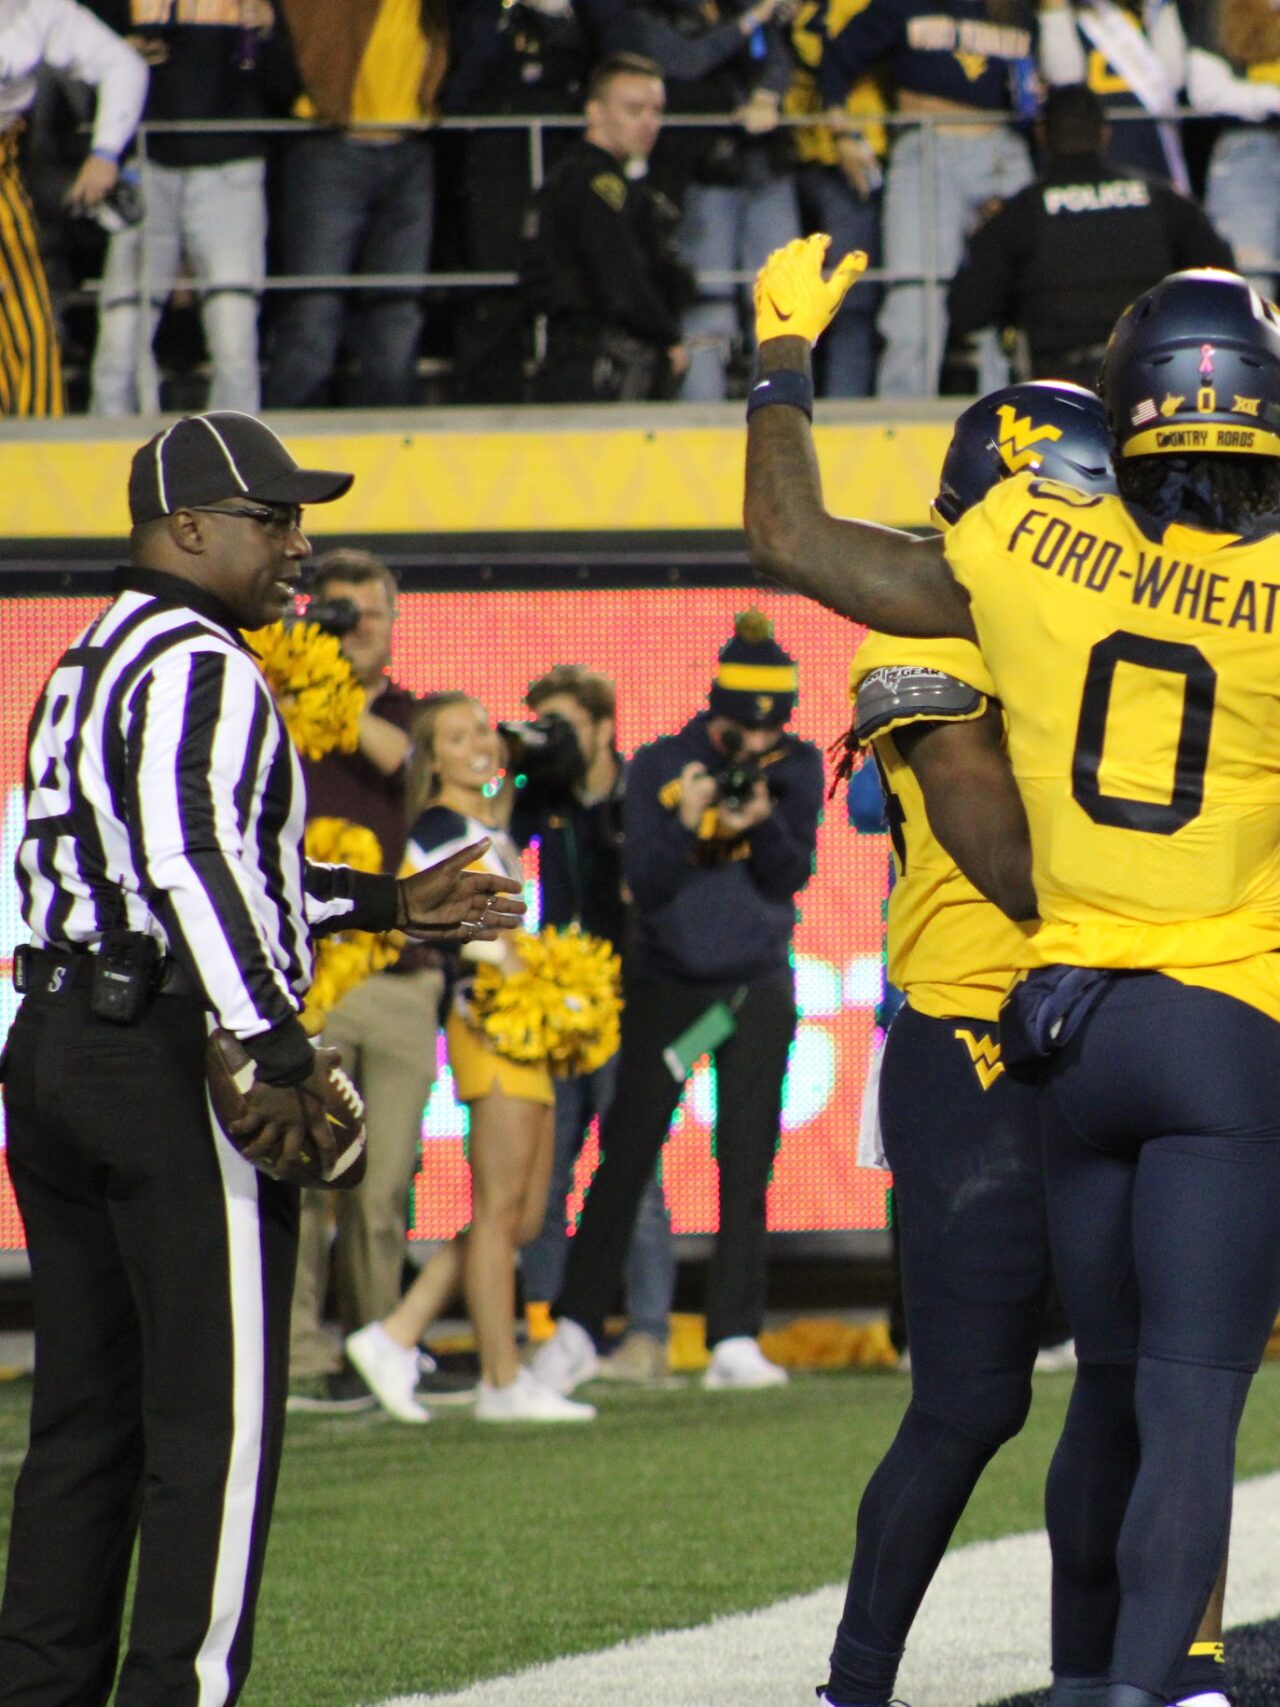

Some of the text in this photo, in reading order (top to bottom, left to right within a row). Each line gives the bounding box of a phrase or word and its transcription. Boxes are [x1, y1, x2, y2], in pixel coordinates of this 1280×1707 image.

[1043, 180, 1151, 214] POLICE
[1197, 387, 1217, 414] 0
[1217, 430, 1254, 448] ROADS
[1071, 629, 1218, 836] 0
